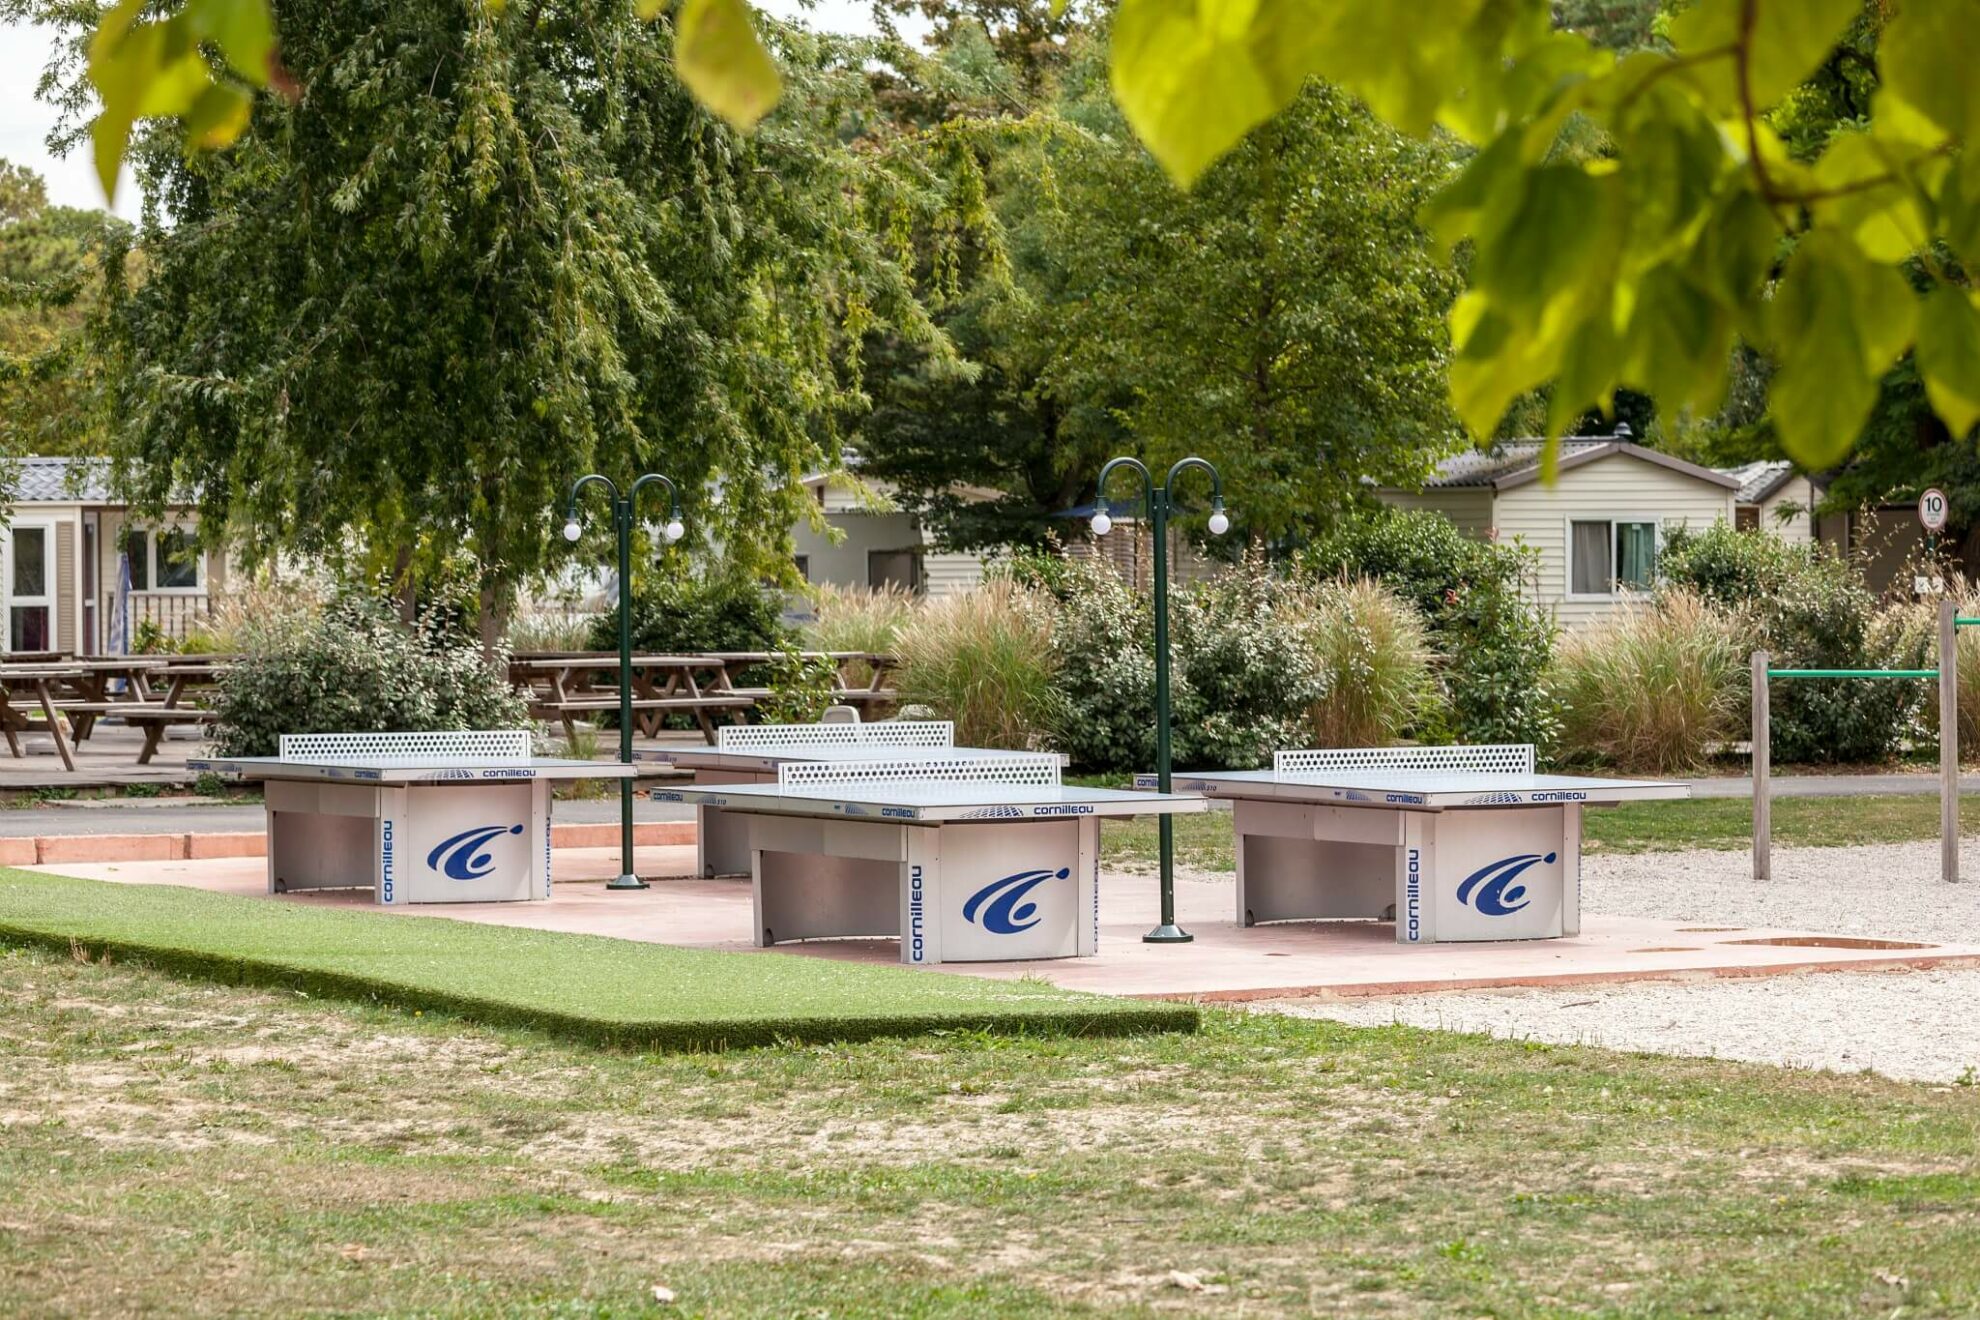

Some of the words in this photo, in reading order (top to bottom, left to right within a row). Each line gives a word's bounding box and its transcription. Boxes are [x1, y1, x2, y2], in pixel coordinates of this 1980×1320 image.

[1924, 496, 1942, 512] 10
[483, 769, 536, 777] cornilleau
[1531, 791, 1587, 801] cornilleau
[1033, 805, 1094, 815] cornilleau
[1407, 849, 1419, 941] cornilleau
[910, 865, 923, 962] cornilleau
